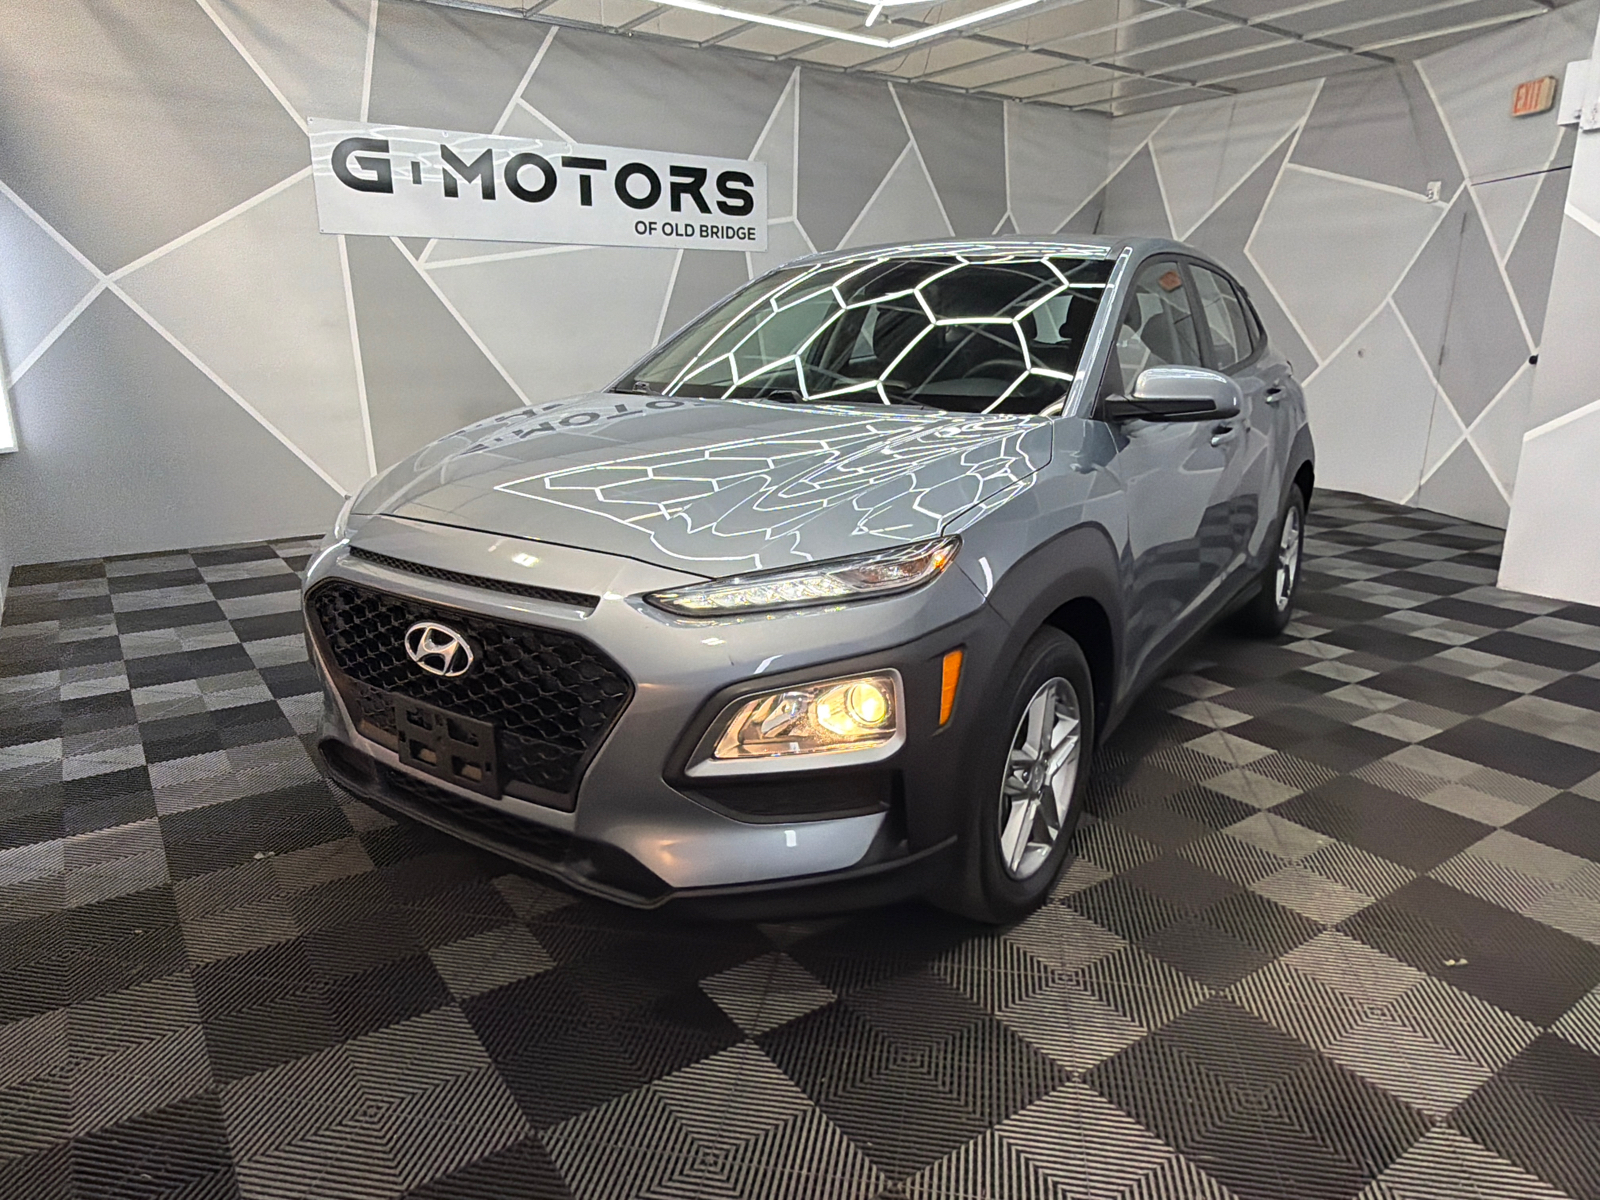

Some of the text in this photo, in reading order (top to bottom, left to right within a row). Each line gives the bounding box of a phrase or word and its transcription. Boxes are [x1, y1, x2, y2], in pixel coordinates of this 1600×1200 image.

[634, 220, 756, 241] OF OLD BRIDGE
